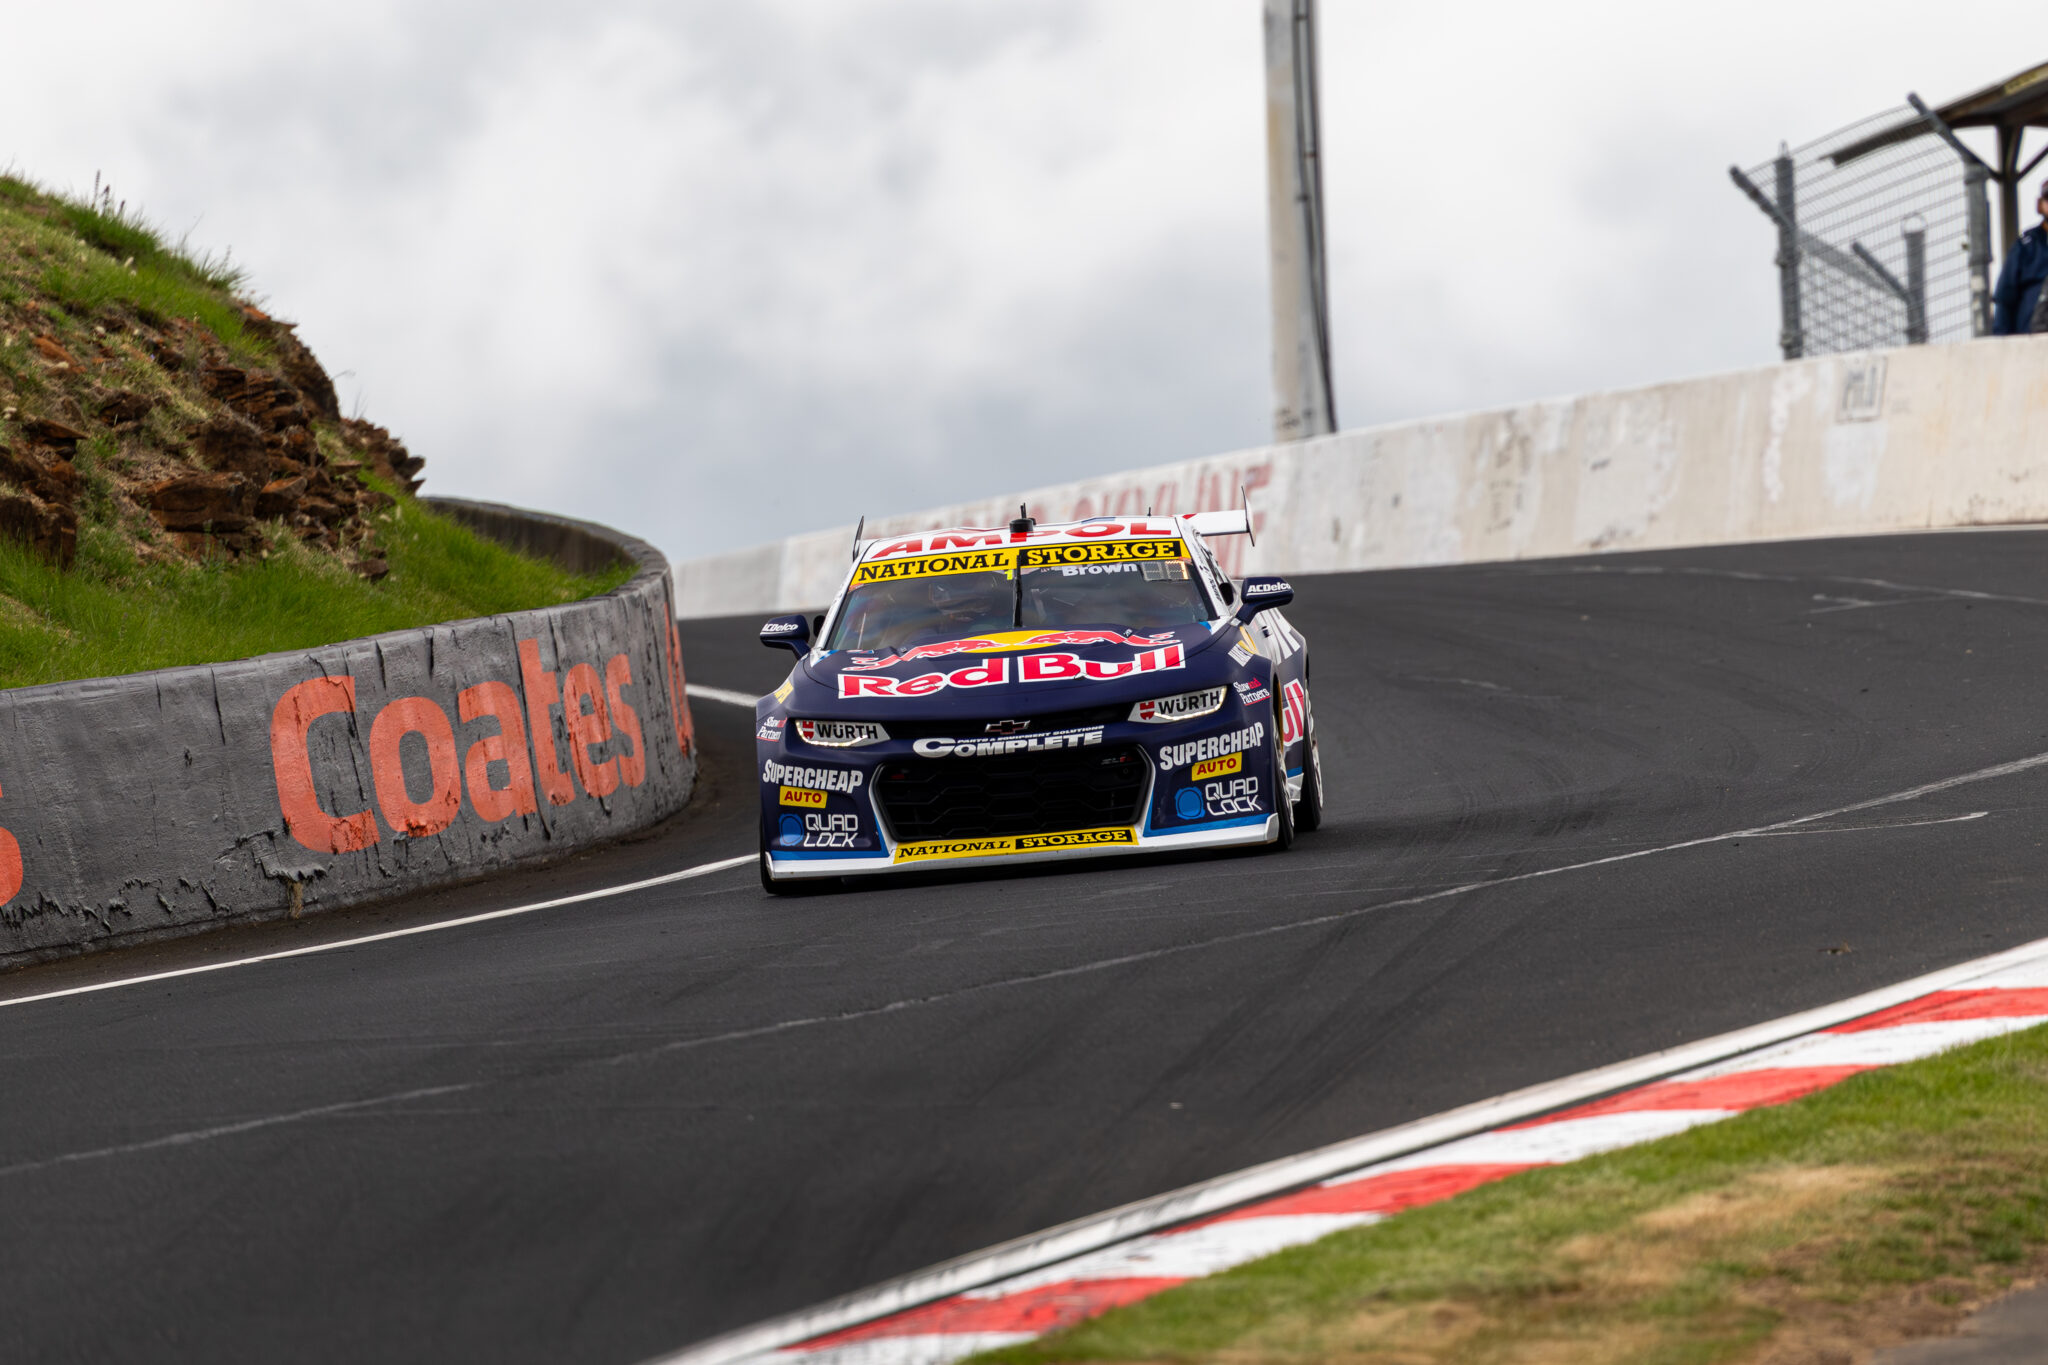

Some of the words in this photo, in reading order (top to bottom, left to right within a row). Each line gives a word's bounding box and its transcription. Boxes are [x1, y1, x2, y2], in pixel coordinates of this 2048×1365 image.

[871, 522, 1172, 559] AMPOL
[858, 552, 1009, 582] NATIONAL
[1027, 542, 1174, 565] STORAGE
[1062, 562, 1138, 577] Brown
[838, 657, 1010, 699] Red
[1017, 643, 1186, 683] Bull
[270, 638, 646, 855] Coates
[912, 730, 1104, 758] COMPLETE
[1159, 721, 1265, 771] SUPERCHEAP
[762, 759, 864, 794] SUPERCHEAP
[1196, 757, 1237, 776] AUTO
[784, 790, 822, 804] AUTO
[1204, 776, 1259, 802] QUAD
[1206, 794, 1263, 816] LOCK
[805, 813, 859, 831] QUAD
[803, 832, 859, 848] LOCK
[898, 839, 1012, 859] NATIONAL
[1022, 829, 1128, 848] STORAGE
